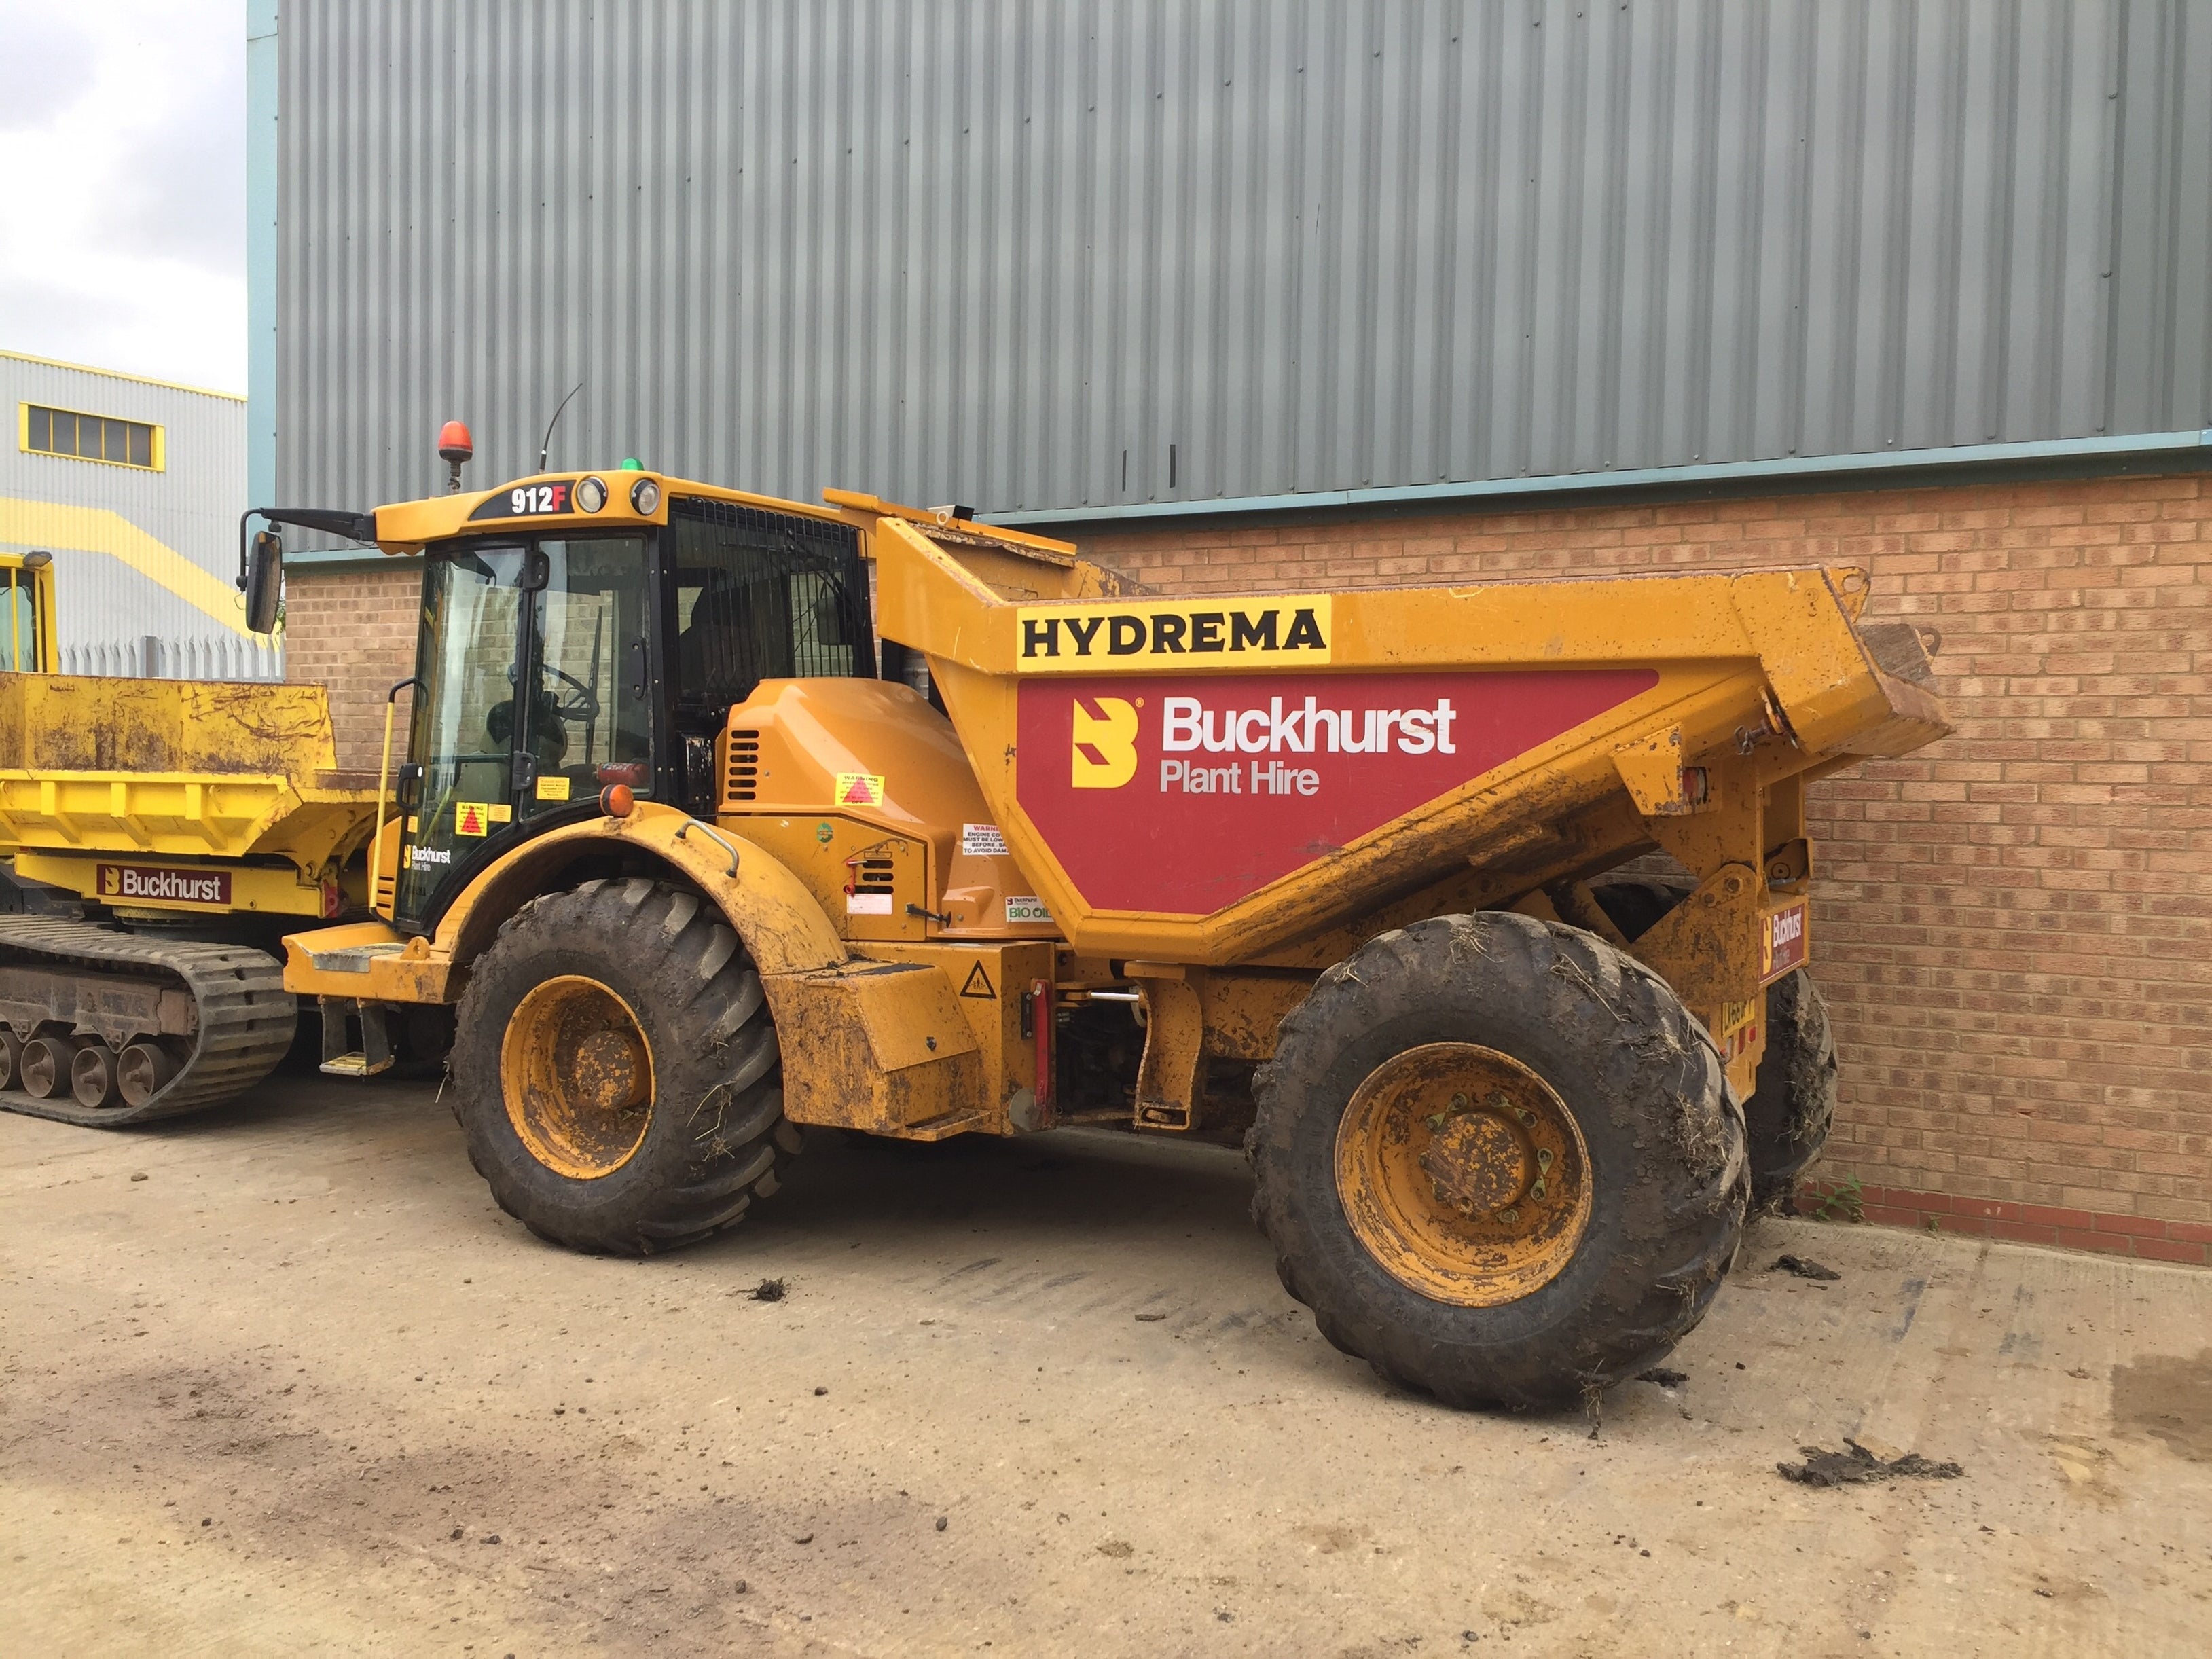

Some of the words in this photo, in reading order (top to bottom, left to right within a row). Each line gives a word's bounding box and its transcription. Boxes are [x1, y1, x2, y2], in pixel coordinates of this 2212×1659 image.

[511, 486, 566, 514] 912F
[1021, 608, 1327, 659] HYDREMA
[1161, 695, 1457, 755] Buckhurst
[1160, 759, 1242, 795] Plant
[1250, 760, 1320, 796] Hire
[412, 845, 451, 864] Buckhurst
[123, 868, 221, 901] Buckhurst
[1009, 907, 1031, 918] BIO
